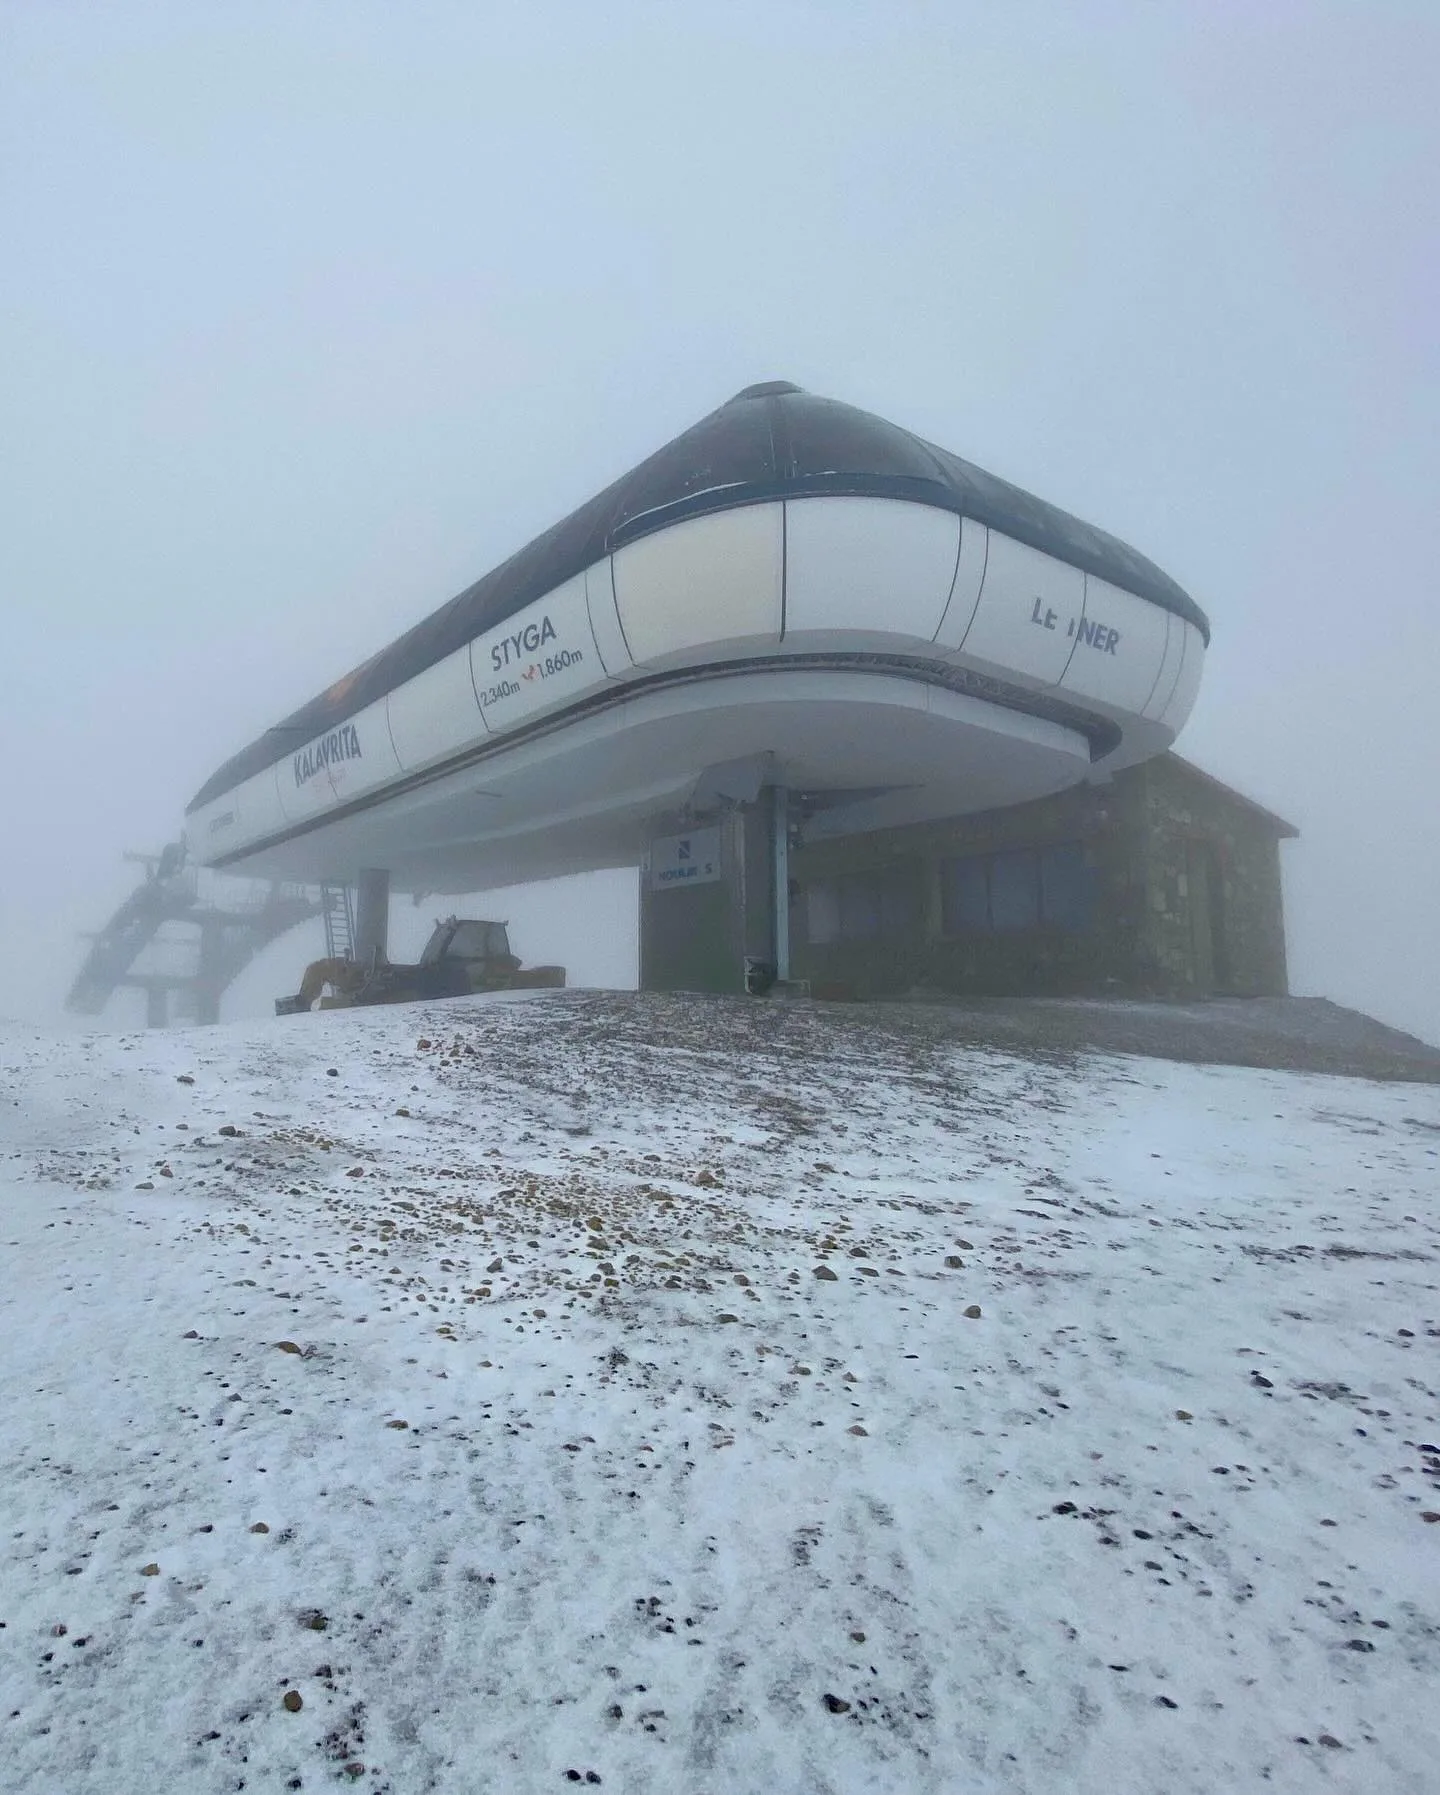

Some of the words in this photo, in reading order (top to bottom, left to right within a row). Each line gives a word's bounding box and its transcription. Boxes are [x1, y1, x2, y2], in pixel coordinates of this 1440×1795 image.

[491, 615, 557, 672] STYGA
[480, 680, 521, 707] 2.340m
[536, 649, 583, 680] 1.860m
[294, 723, 362, 788] KALAVRITA
